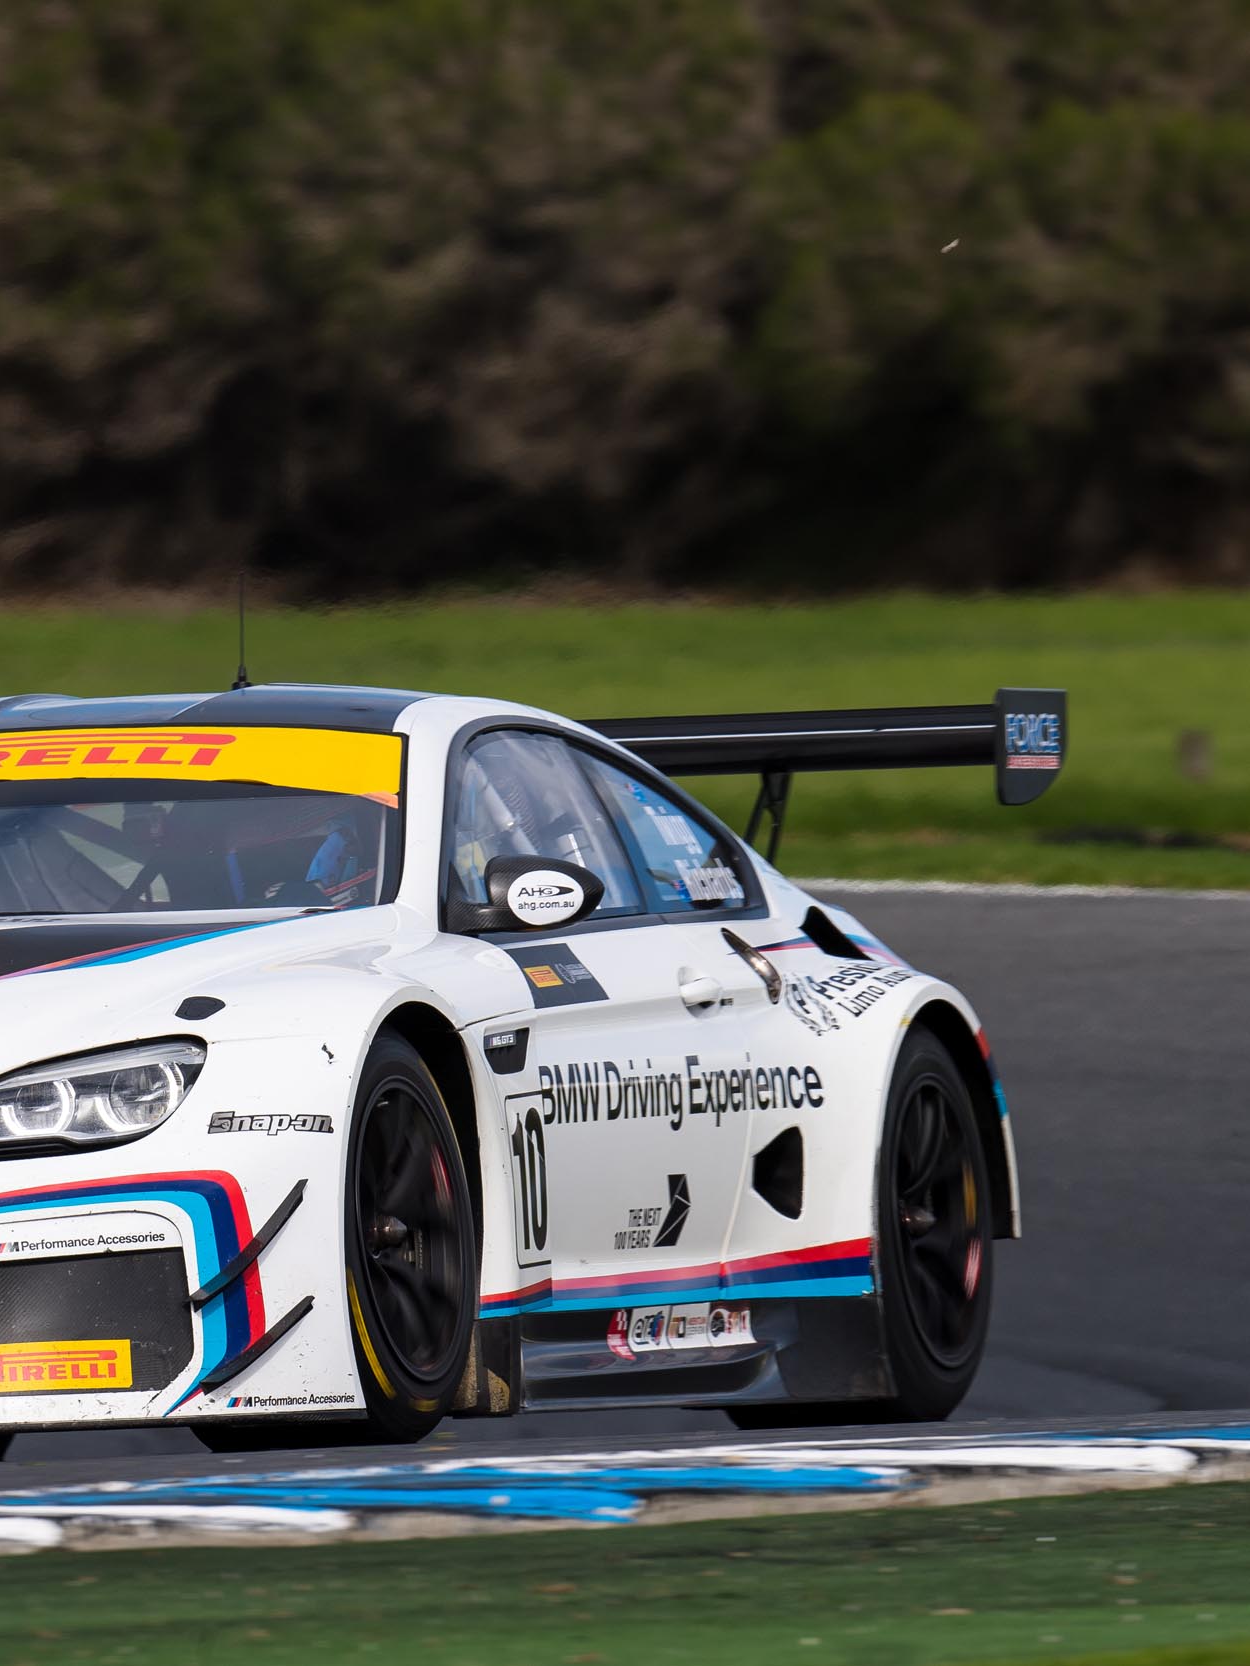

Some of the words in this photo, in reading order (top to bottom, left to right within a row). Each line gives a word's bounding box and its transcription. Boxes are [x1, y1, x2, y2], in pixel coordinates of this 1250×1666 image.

[517, 886, 554, 898] AHG
[517, 900, 575, 911] ahg.com.au
[836, 984, 886, 1018] Limo
[538, 1062, 599, 1126] BMW
[603, 1058, 683, 1132] Driving
[685, 1051, 825, 1128] Experience
[207, 1110, 334, 1136] Snap-on
[511, 1107, 548, 1252] 10
[21, 1239, 95, 1252] Performance
[96, 1232, 166, 1246] Accessories
[627, 1229, 650, 1249] YEARS
[253, 1396, 308, 1408] Performance
[308, 1393, 356, 1405] Accessories
